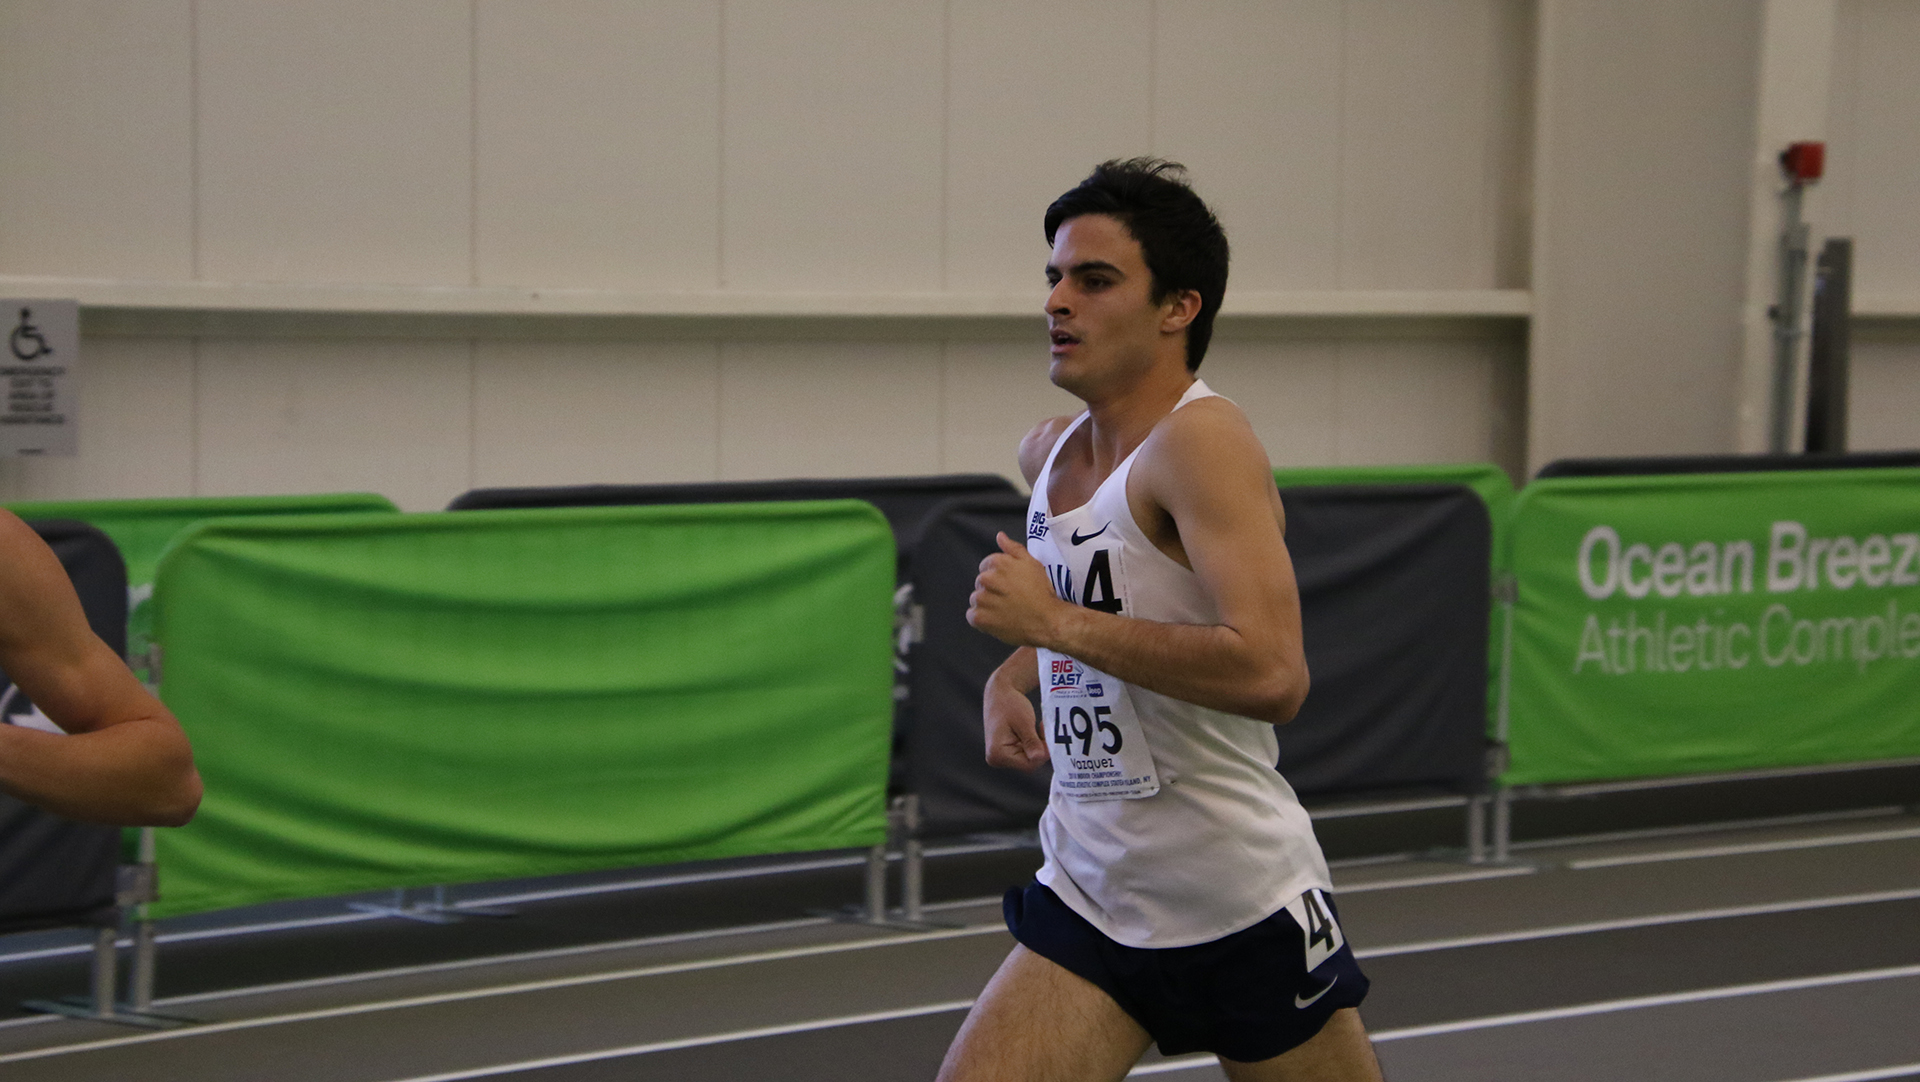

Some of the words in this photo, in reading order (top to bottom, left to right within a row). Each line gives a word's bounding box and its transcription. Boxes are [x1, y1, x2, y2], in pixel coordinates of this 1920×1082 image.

[1029, 524, 1050, 537] EAST
[1031, 511, 1046, 524] BIG
[1577, 524, 1754, 600] Ocean
[1766, 520, 1920, 593] Breez
[1082, 549, 1123, 615] 4
[1573, 609, 1751, 675] Athletic
[1051, 660, 1073, 673] BIG
[1051, 673, 1082, 686] EAST
[1054, 705, 1123, 757] 495
[1070, 758, 1115, 772] Vazquez
[1301, 889, 1335, 952] 4
